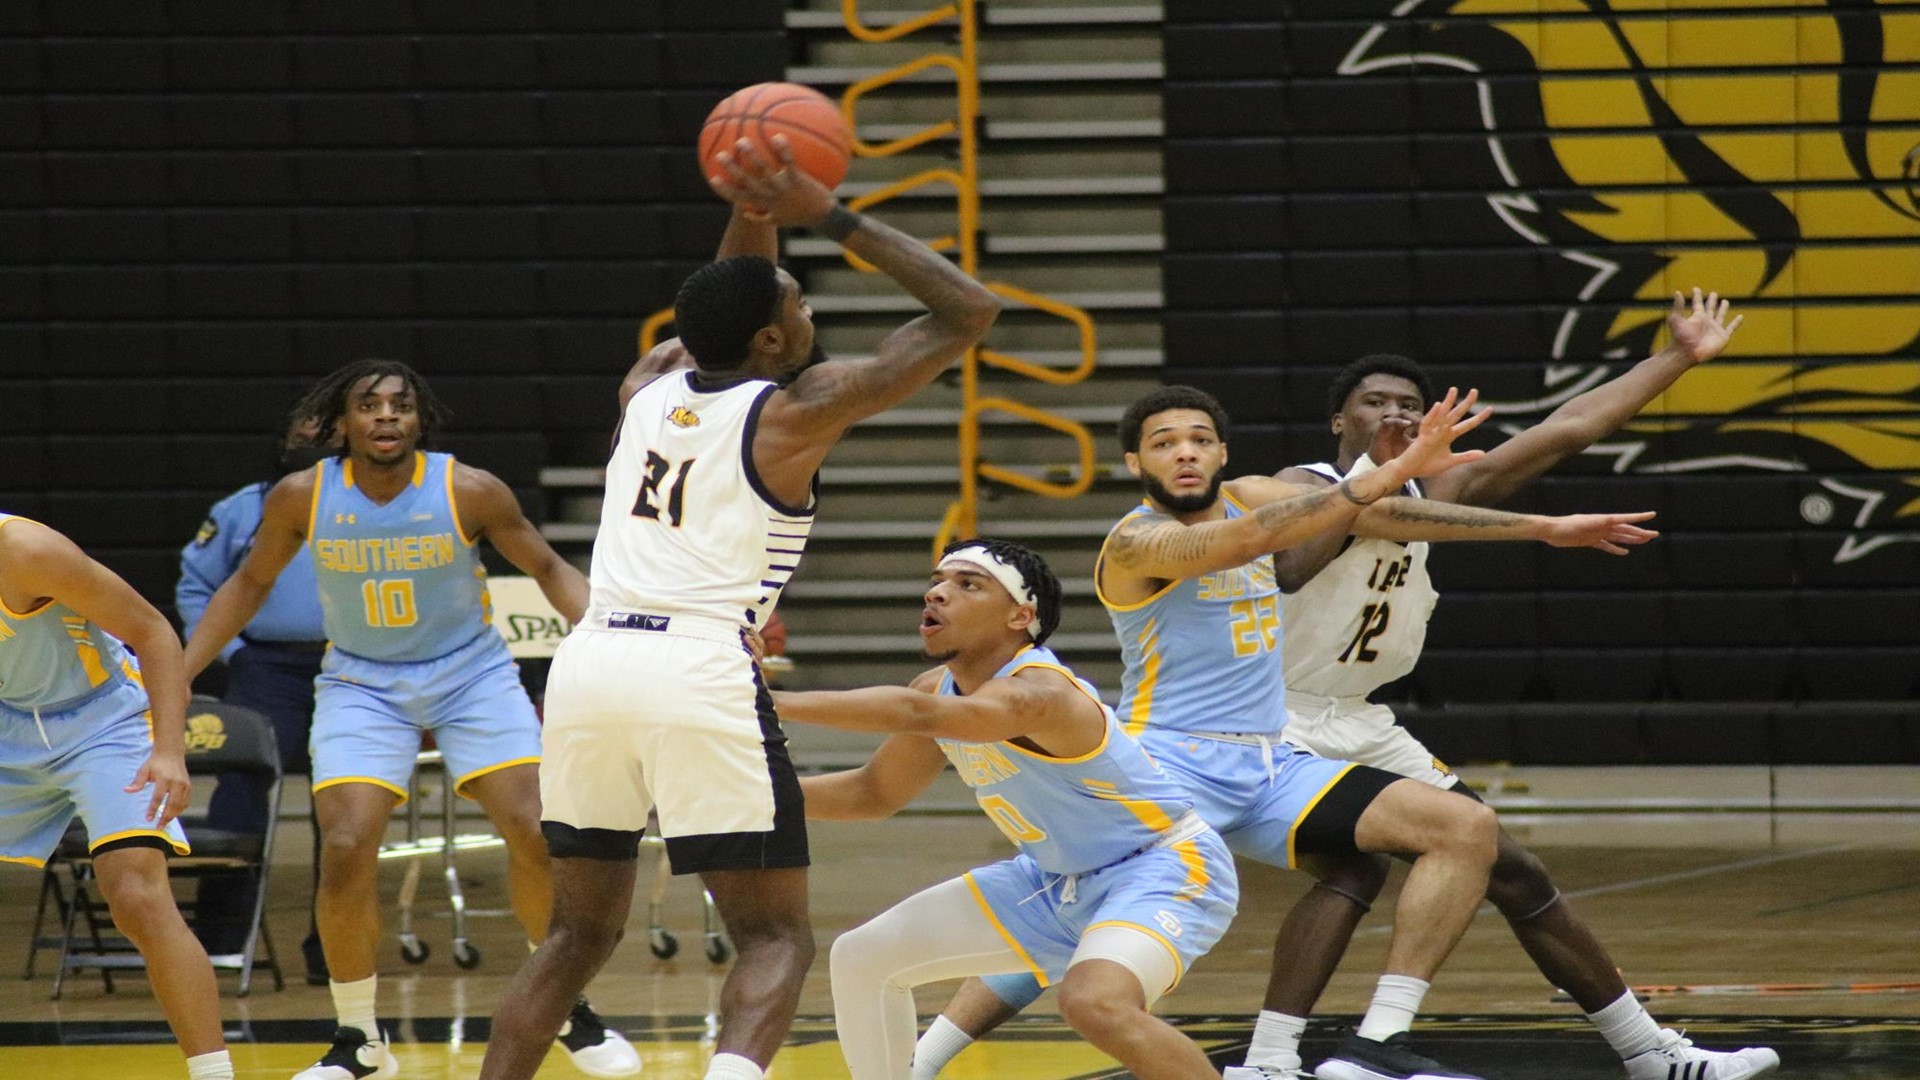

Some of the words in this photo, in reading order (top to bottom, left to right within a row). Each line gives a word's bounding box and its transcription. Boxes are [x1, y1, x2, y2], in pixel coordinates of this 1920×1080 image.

[631, 448, 697, 529] 21
[316, 533, 455, 573] SOUTHERN
[362, 578, 418, 628] 10
[506, 613, 574, 643] SPA
[1229, 594, 1281, 659] 22
[1337, 601, 1391, 664] 12
